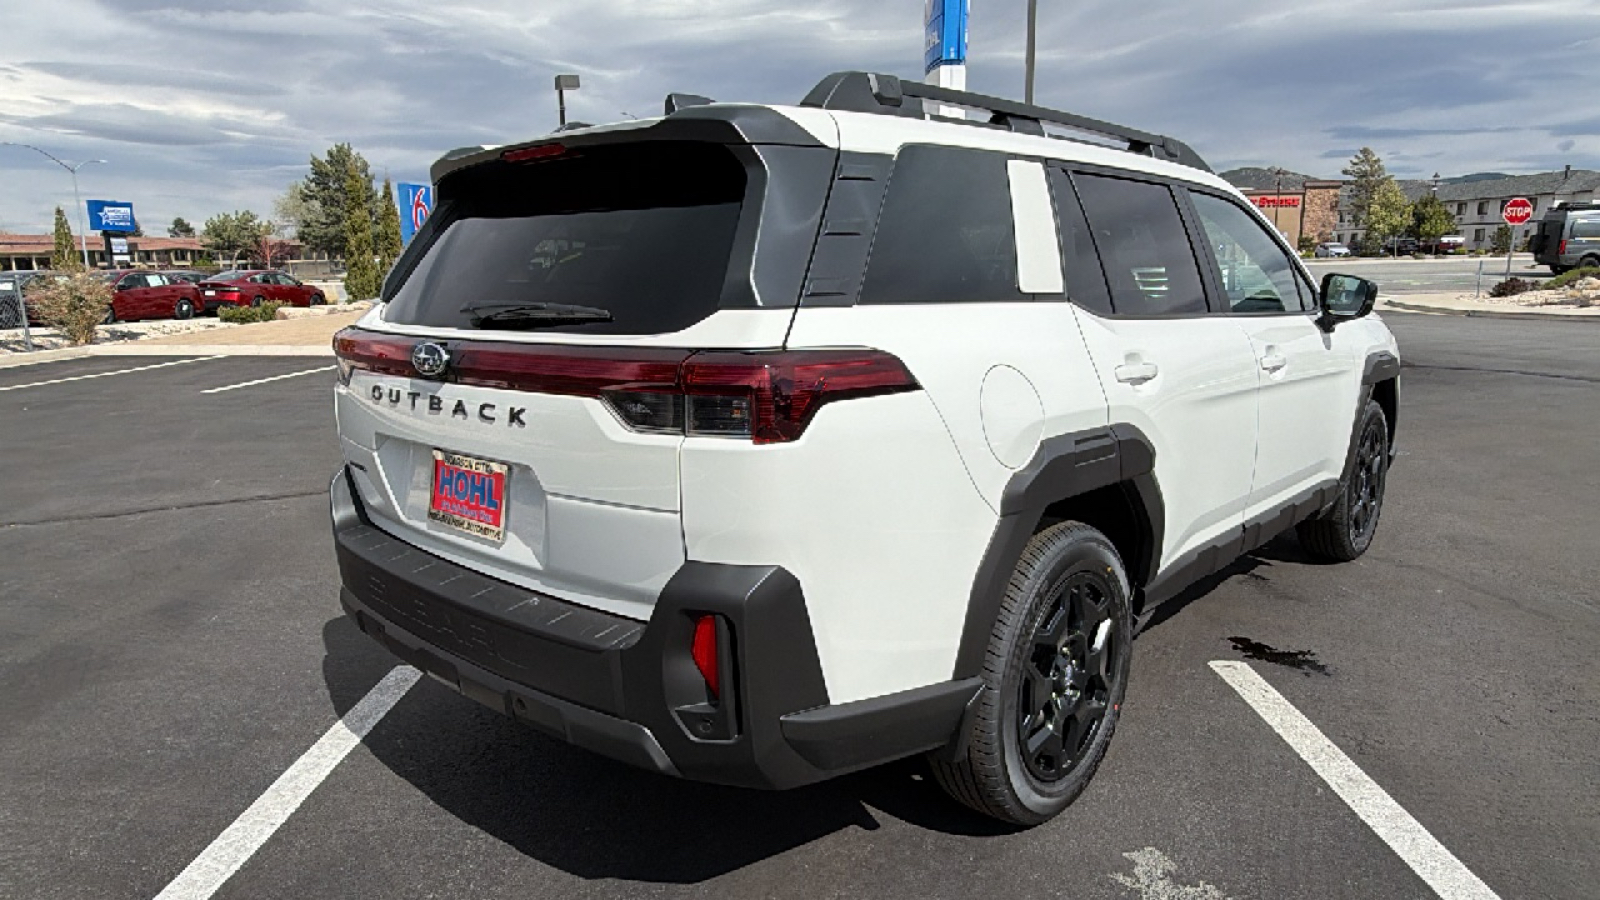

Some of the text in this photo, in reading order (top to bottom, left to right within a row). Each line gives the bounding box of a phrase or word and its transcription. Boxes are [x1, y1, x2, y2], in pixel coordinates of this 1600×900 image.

[1505, 206, 1531, 217] STOP
[372, 385, 527, 428] OUTBACK
[439, 466, 499, 510] HOHL
